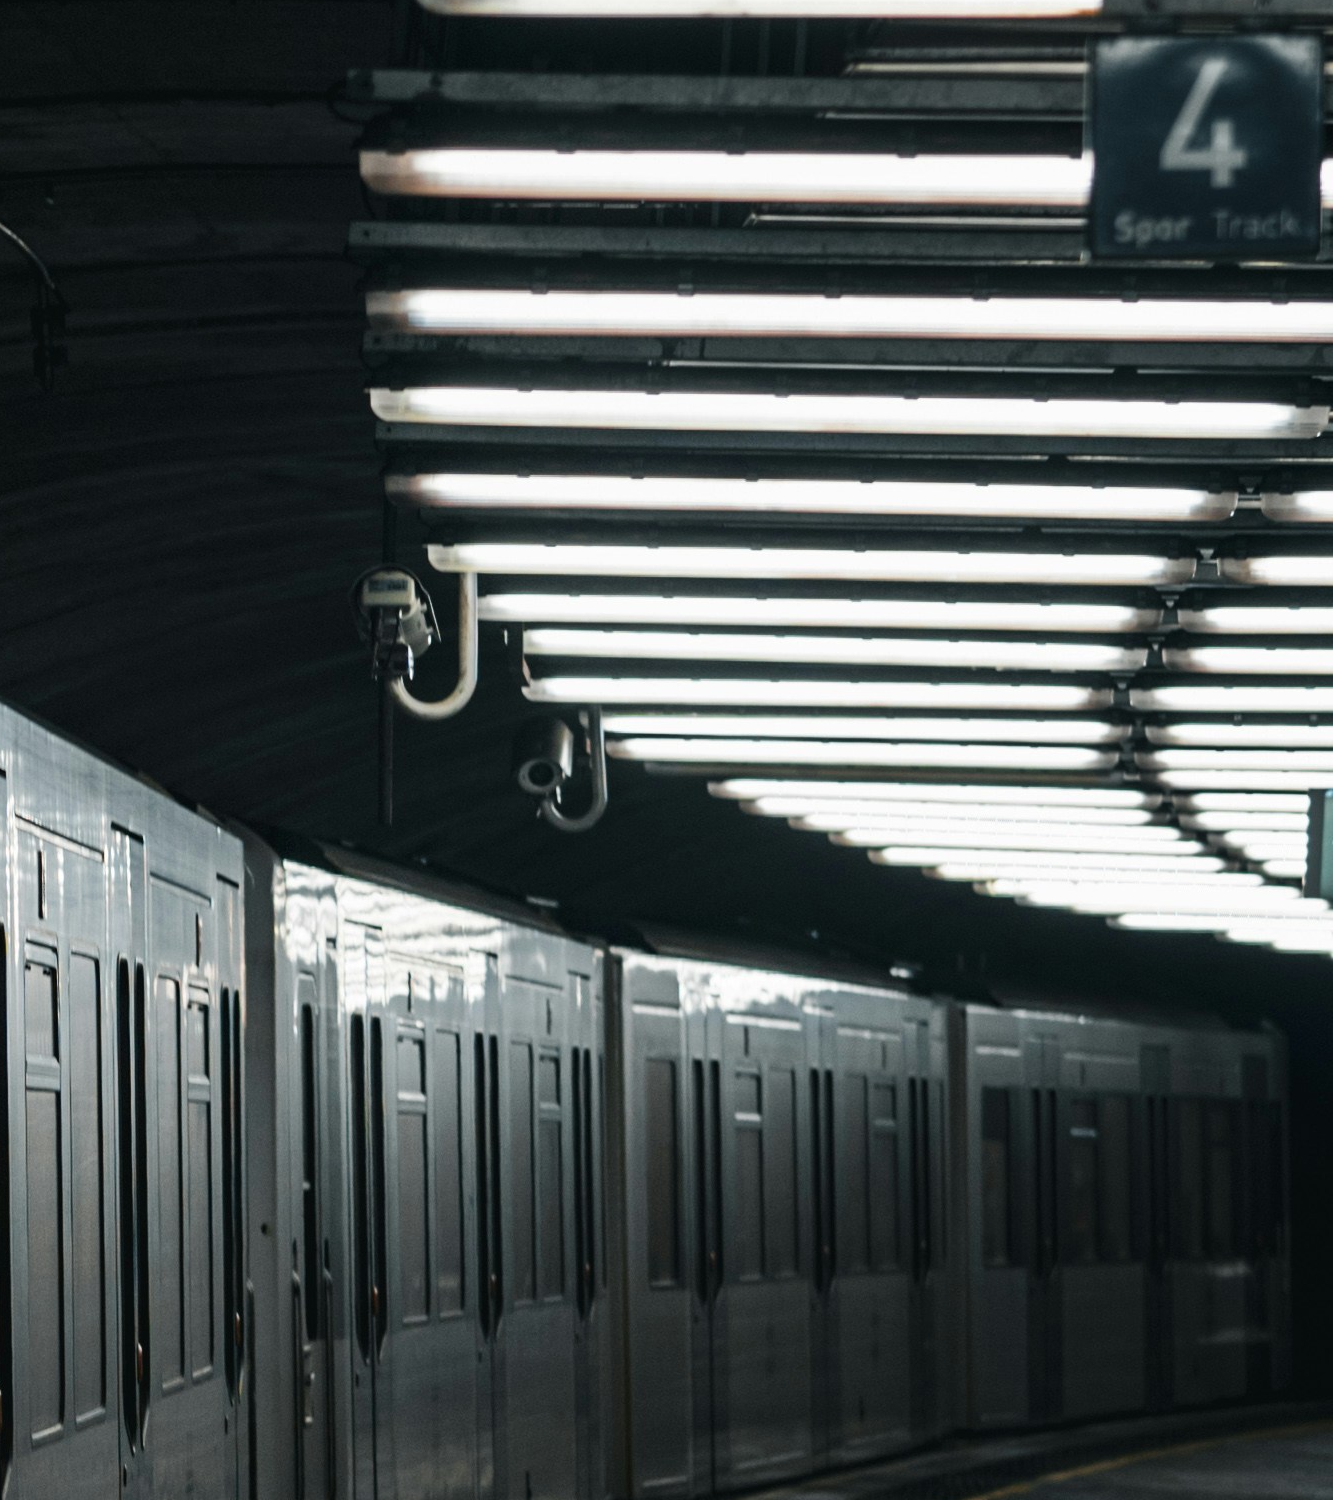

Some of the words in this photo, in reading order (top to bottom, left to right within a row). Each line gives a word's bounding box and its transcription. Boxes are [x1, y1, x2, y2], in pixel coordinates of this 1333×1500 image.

[1159, 58, 1247, 188] 4
[1113, 210, 1192, 248] Spor
[1212, 209, 1300, 240] Track
